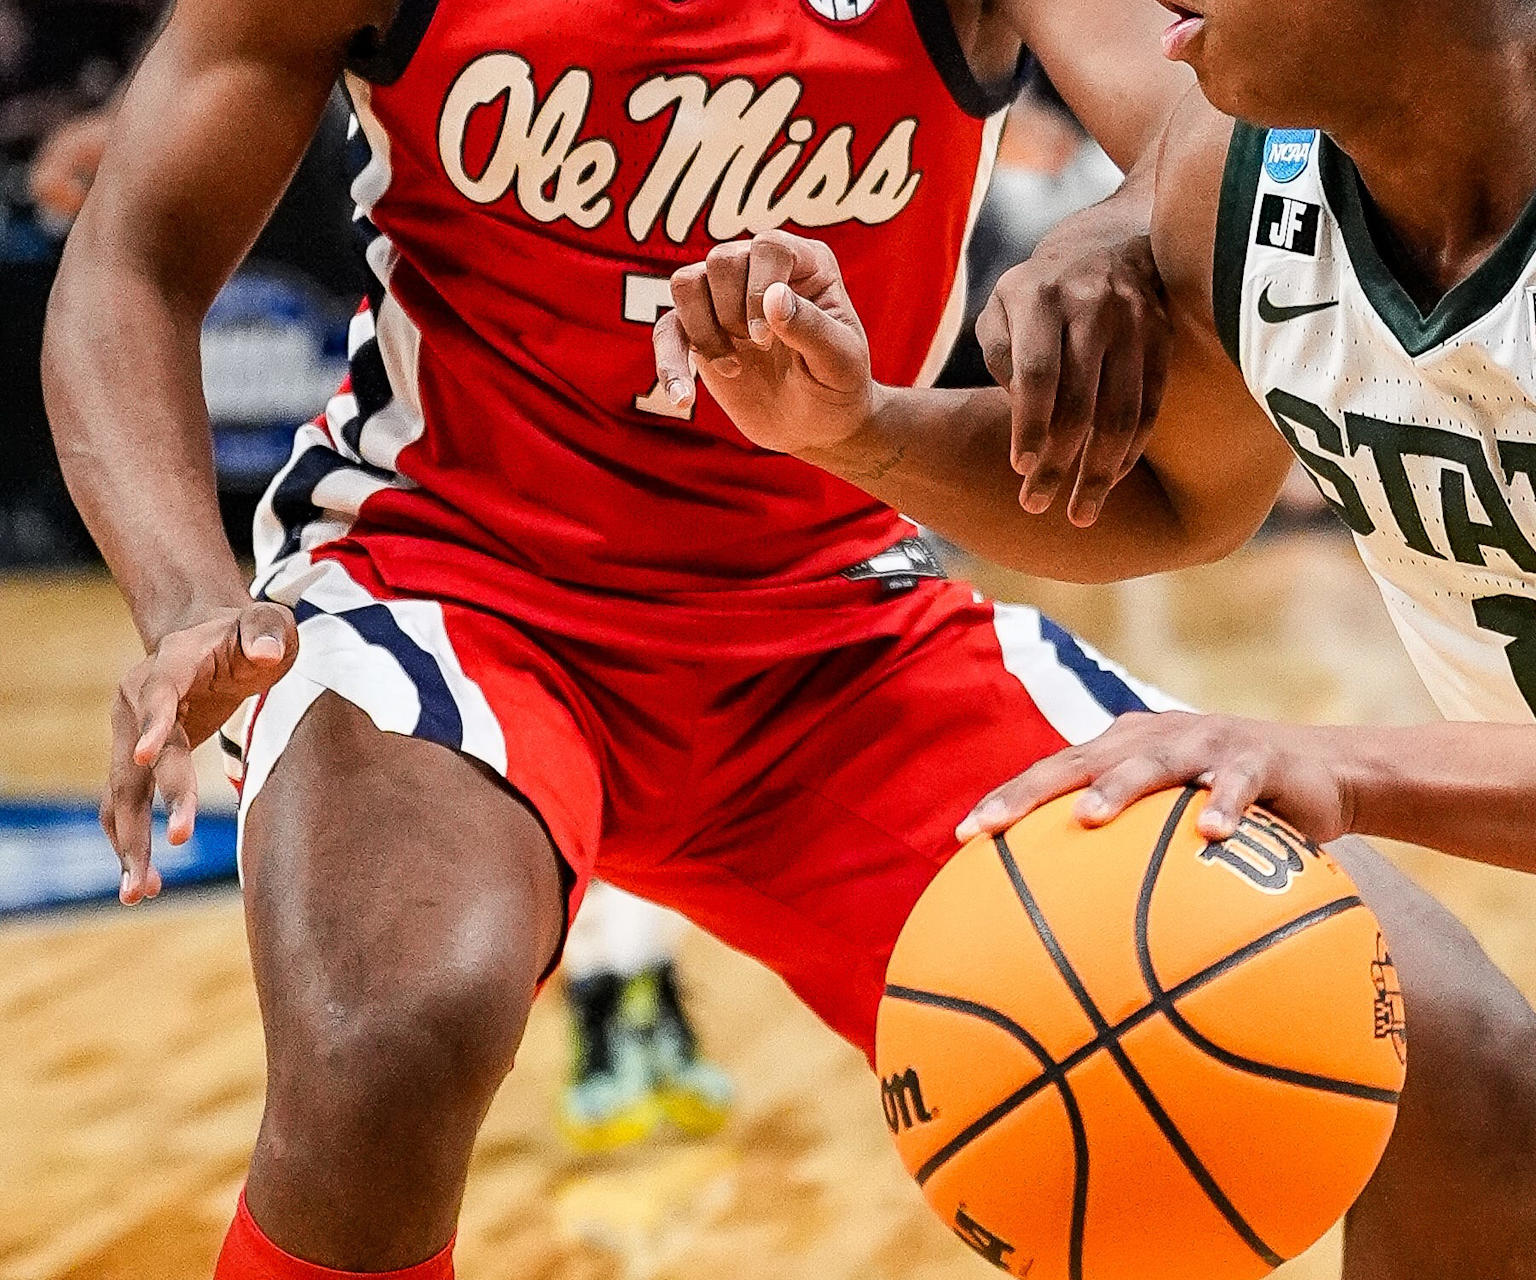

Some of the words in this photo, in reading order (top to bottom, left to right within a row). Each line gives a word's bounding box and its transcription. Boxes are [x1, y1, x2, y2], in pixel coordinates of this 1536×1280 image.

[438, 51, 618, 228] Ole
[625, 72, 922, 244] Miss
[1268, 142, 1311, 163] NCAA
[1269, 198, 1307, 249] JF
